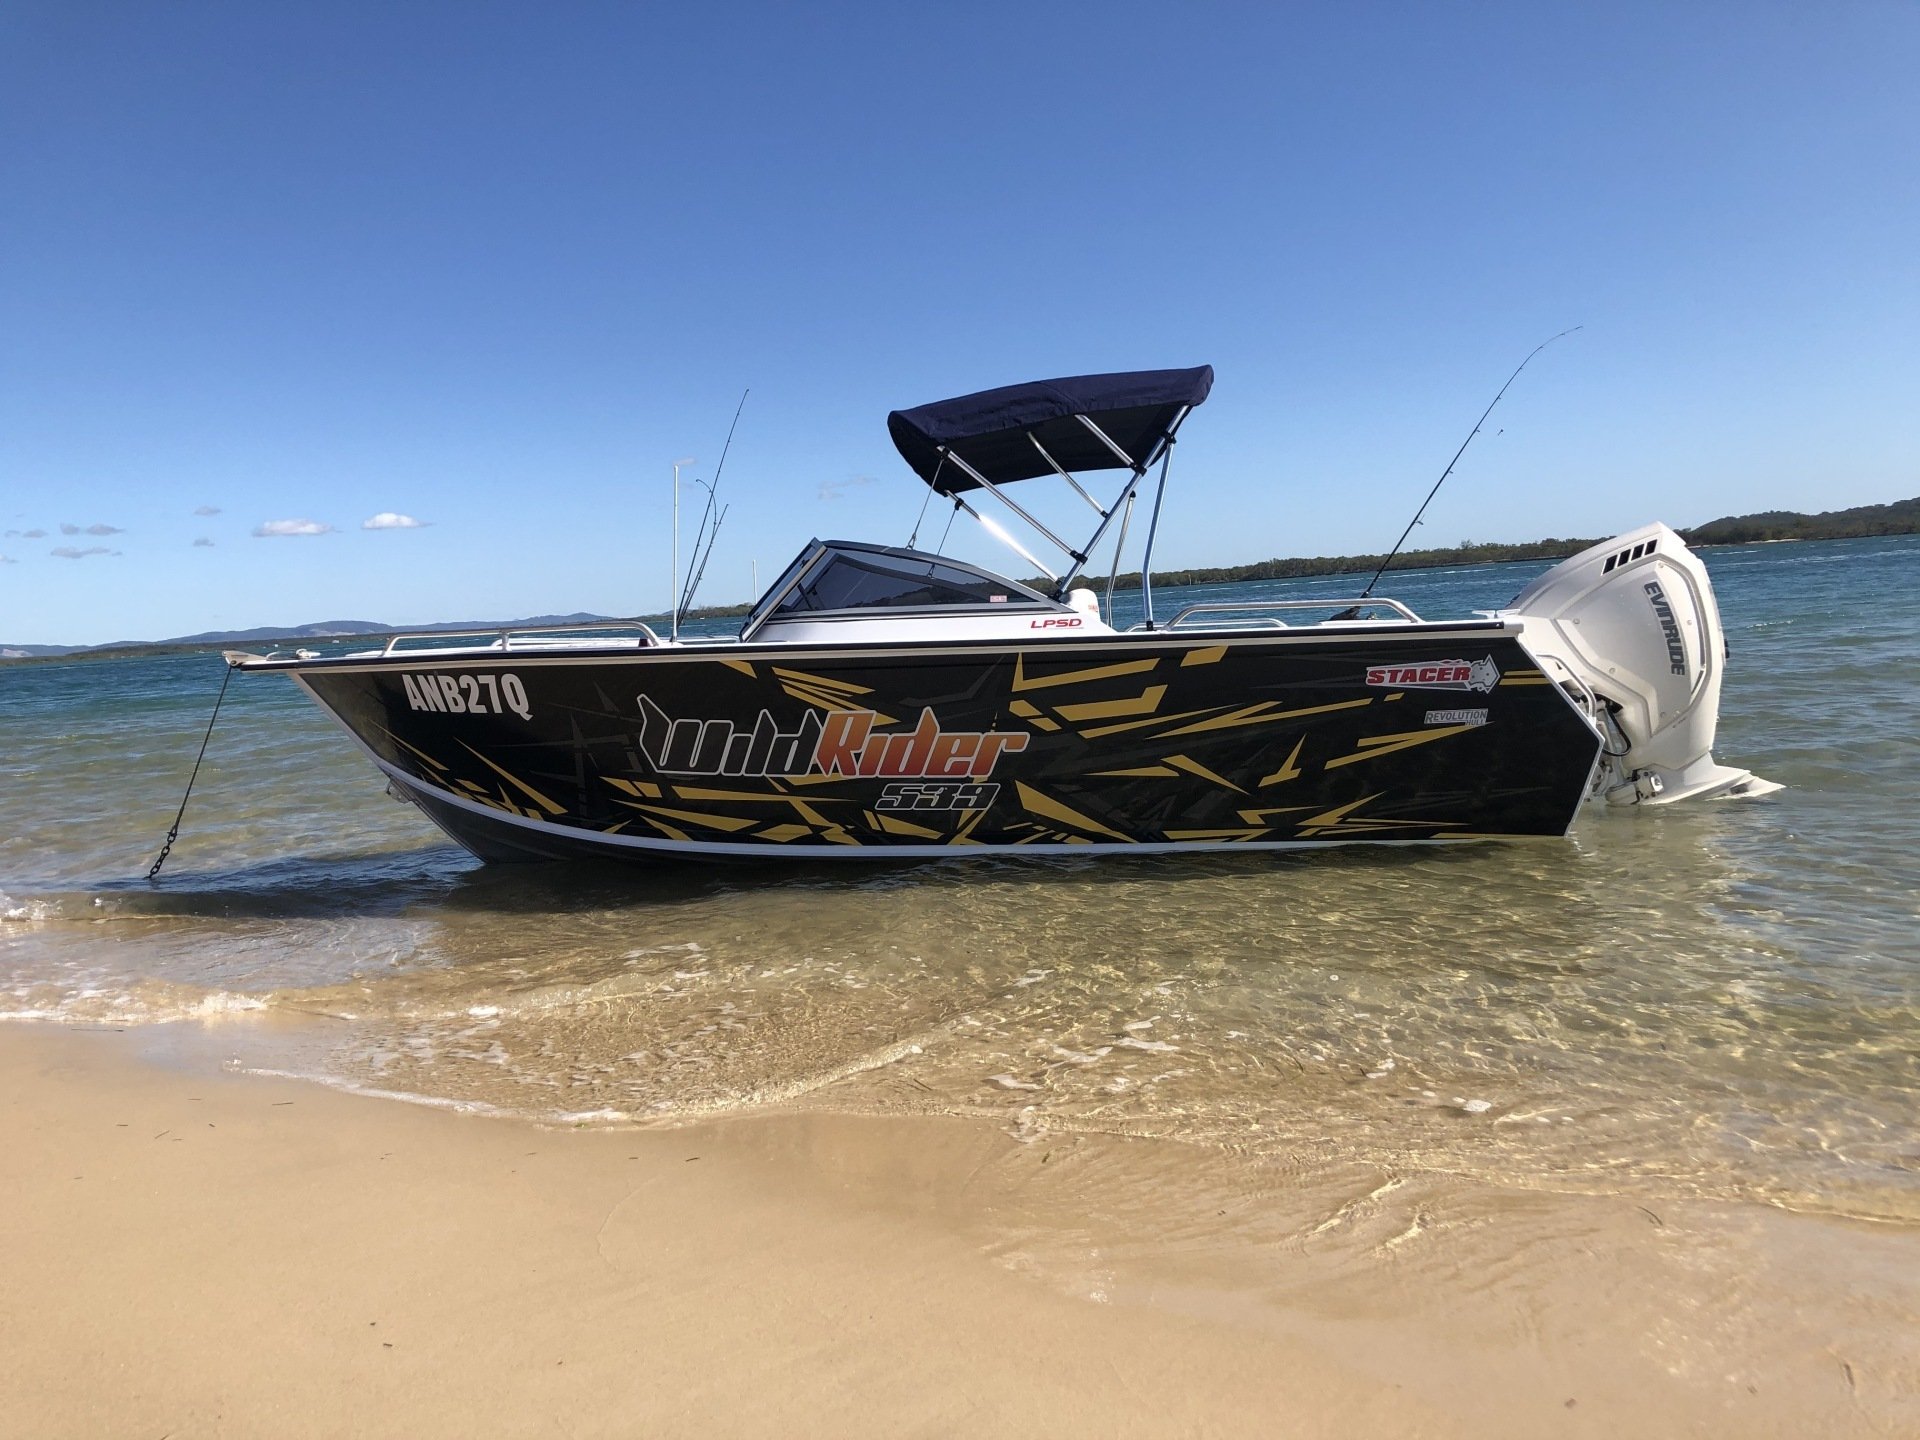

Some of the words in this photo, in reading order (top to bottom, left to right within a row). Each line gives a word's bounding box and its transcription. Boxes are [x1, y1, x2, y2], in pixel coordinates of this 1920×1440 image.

[1031, 618, 1082, 628] LPSD
[1644, 580, 1685, 676] EVINRUDE
[1367, 667, 1471, 684] STACER
[402, 673, 533, 721] ANB27Q
[1426, 710, 1487, 723] REVOLUTION
